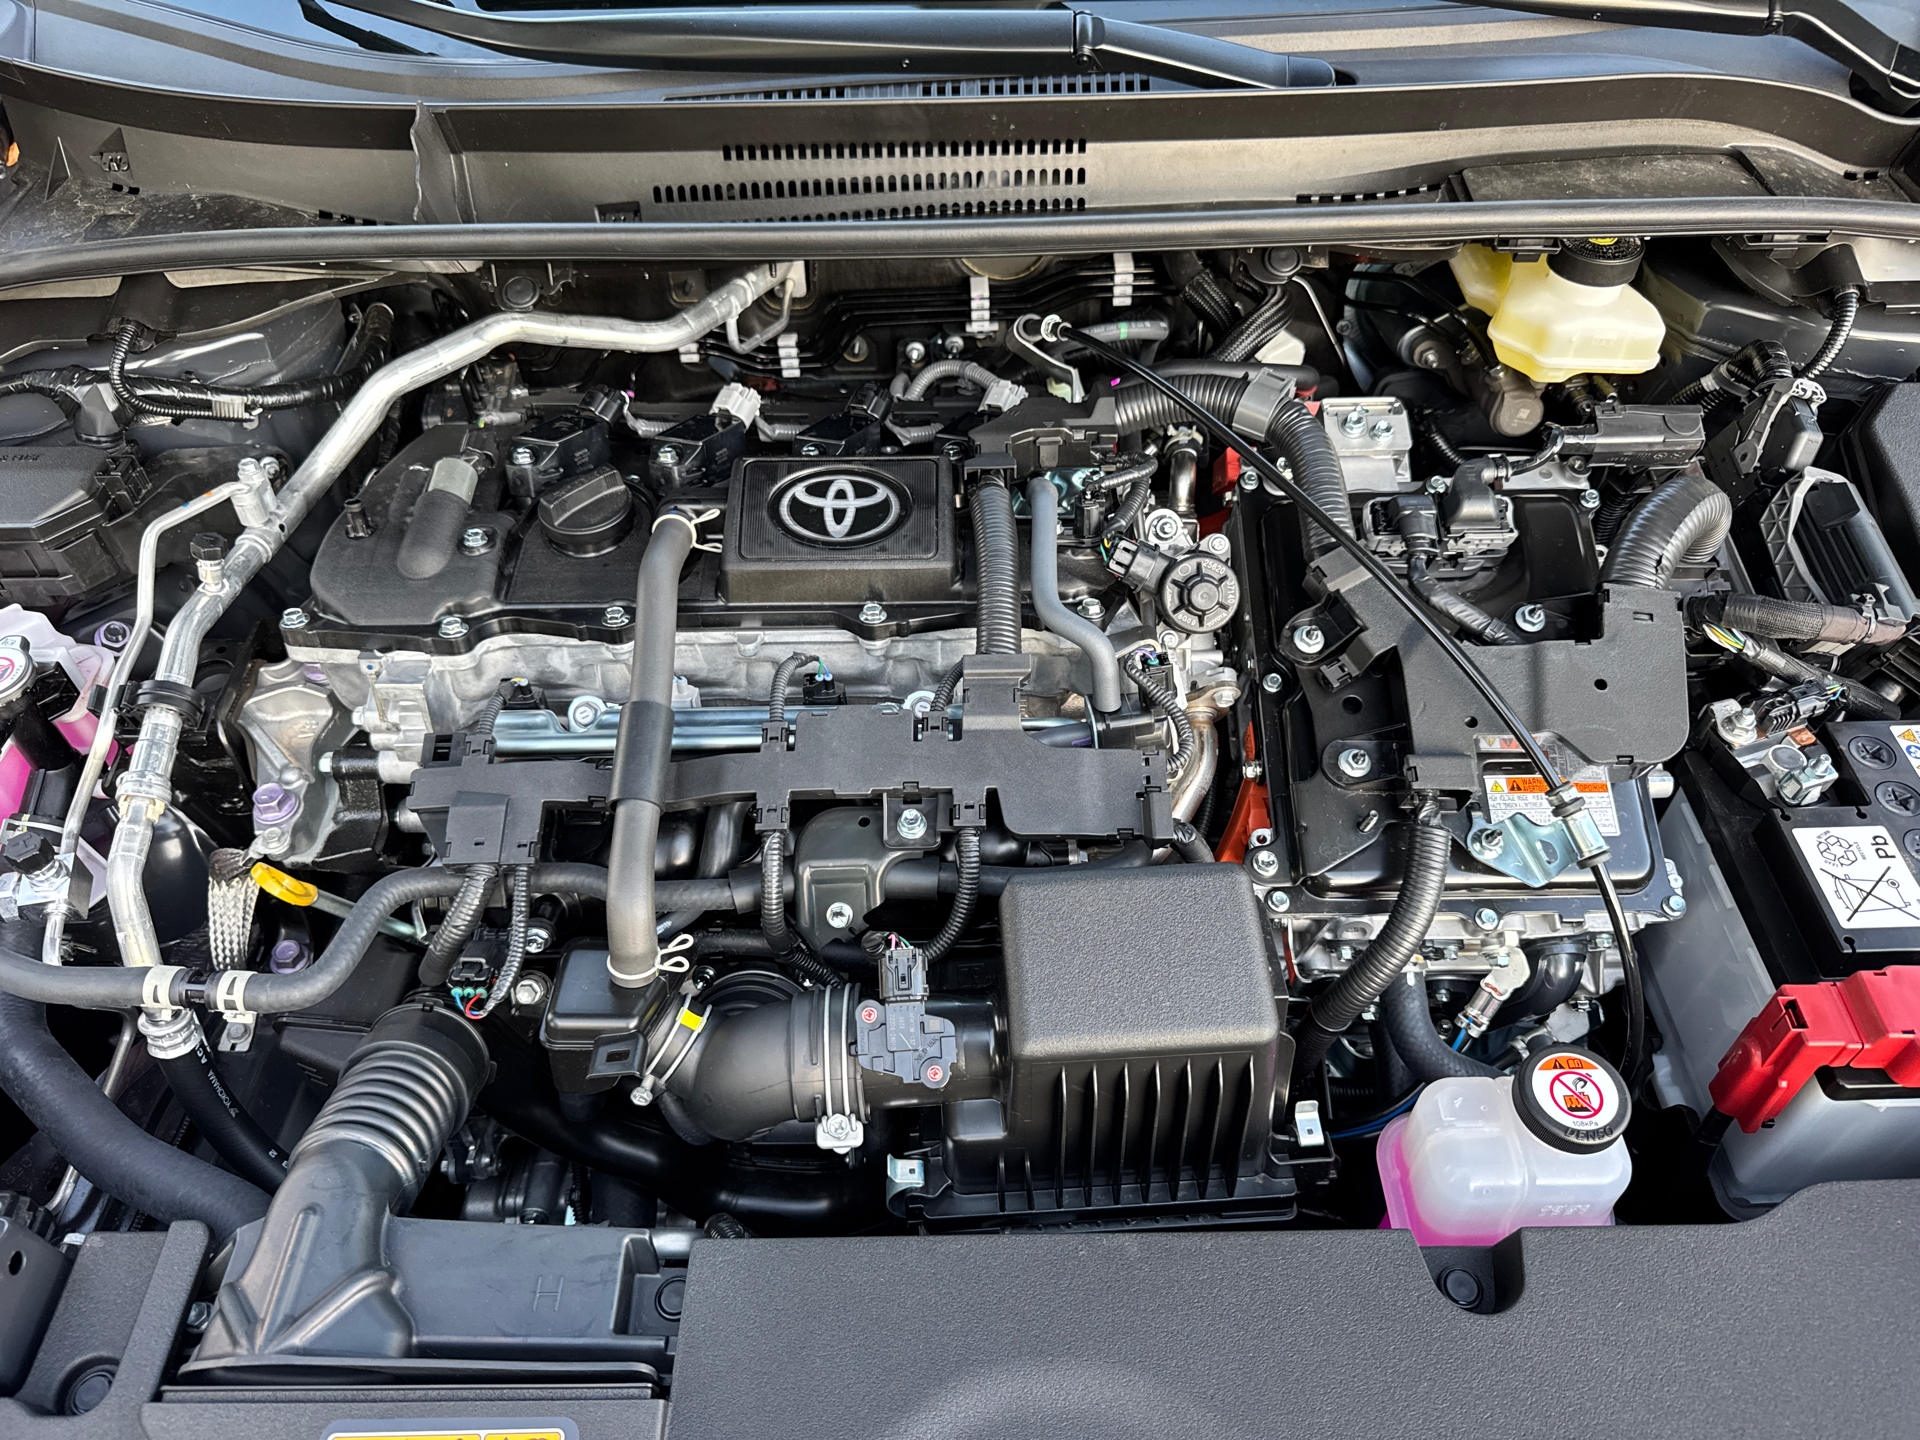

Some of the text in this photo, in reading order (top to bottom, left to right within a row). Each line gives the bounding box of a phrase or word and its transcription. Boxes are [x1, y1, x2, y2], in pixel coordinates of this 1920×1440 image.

[1203, 559, 1225, 574] 25620
[1227, 580, 1235, 604] 37140
[1207, 612, 1227, 627] TOYOTA
[1853, 841, 1867, 860] RECYCLE
[1871, 835, 1896, 859] Pb
[1824, 860, 1839, 868] LEAD
[207, 1068, 232, 1108] YOKOHAMA
[1563, 1126, 1614, 1141] DENSO
[532, 1276, 564, 1311] H
